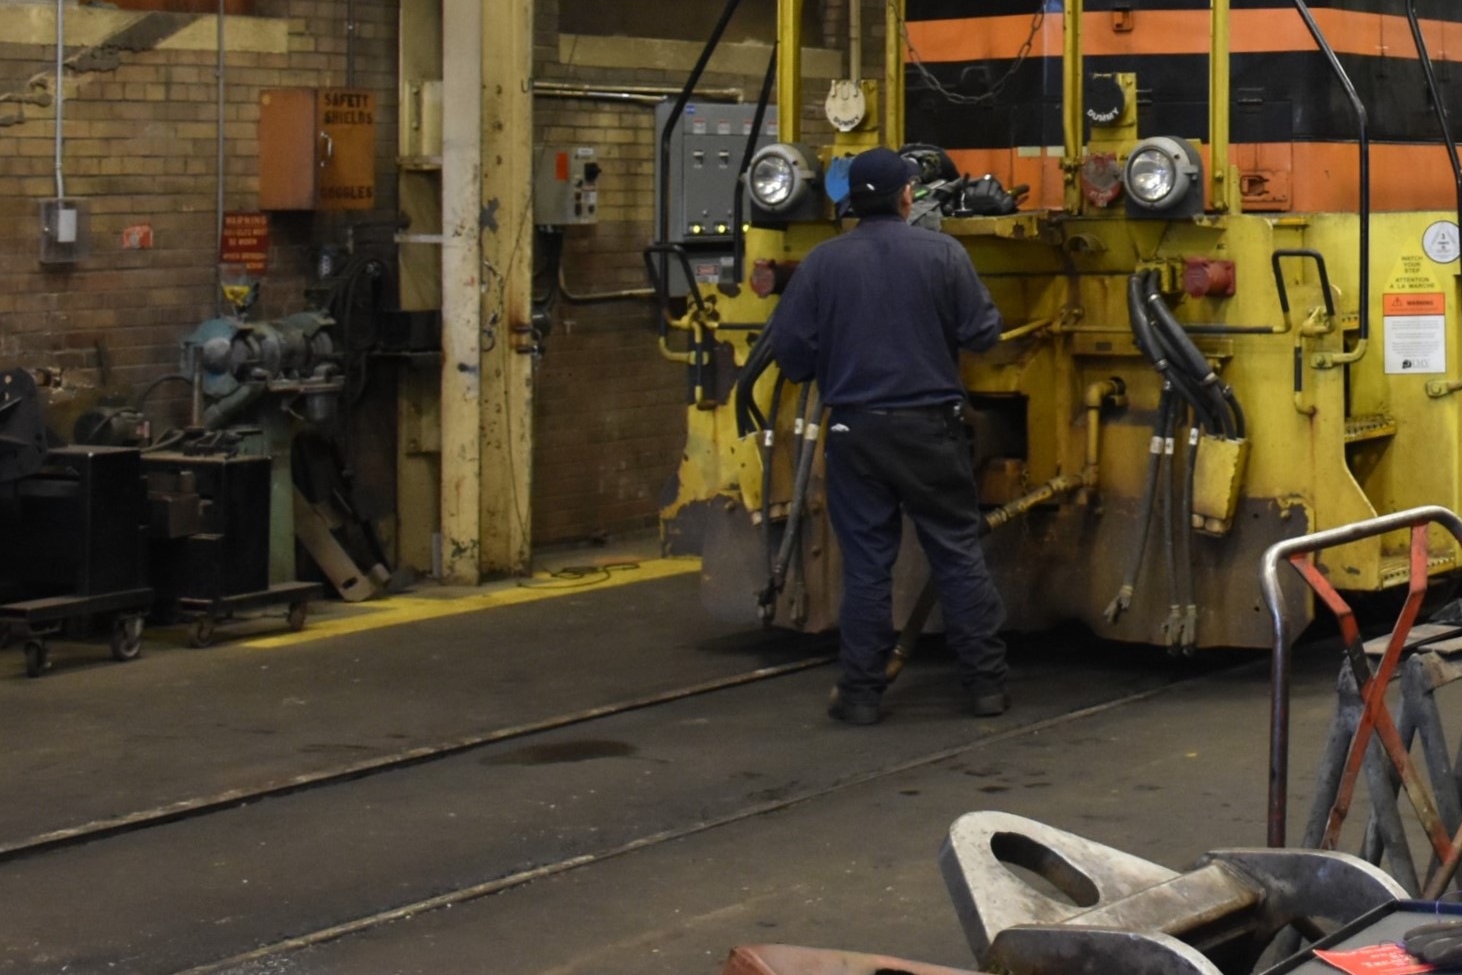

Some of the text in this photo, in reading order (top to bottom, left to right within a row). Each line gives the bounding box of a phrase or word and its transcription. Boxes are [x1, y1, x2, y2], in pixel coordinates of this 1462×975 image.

[324, 92, 369, 108] SAFETY
[324, 109, 374, 125] SHIELDS
[832, 115, 860, 127] DUMMY
[1086, 106, 1119, 122] DUMMY
